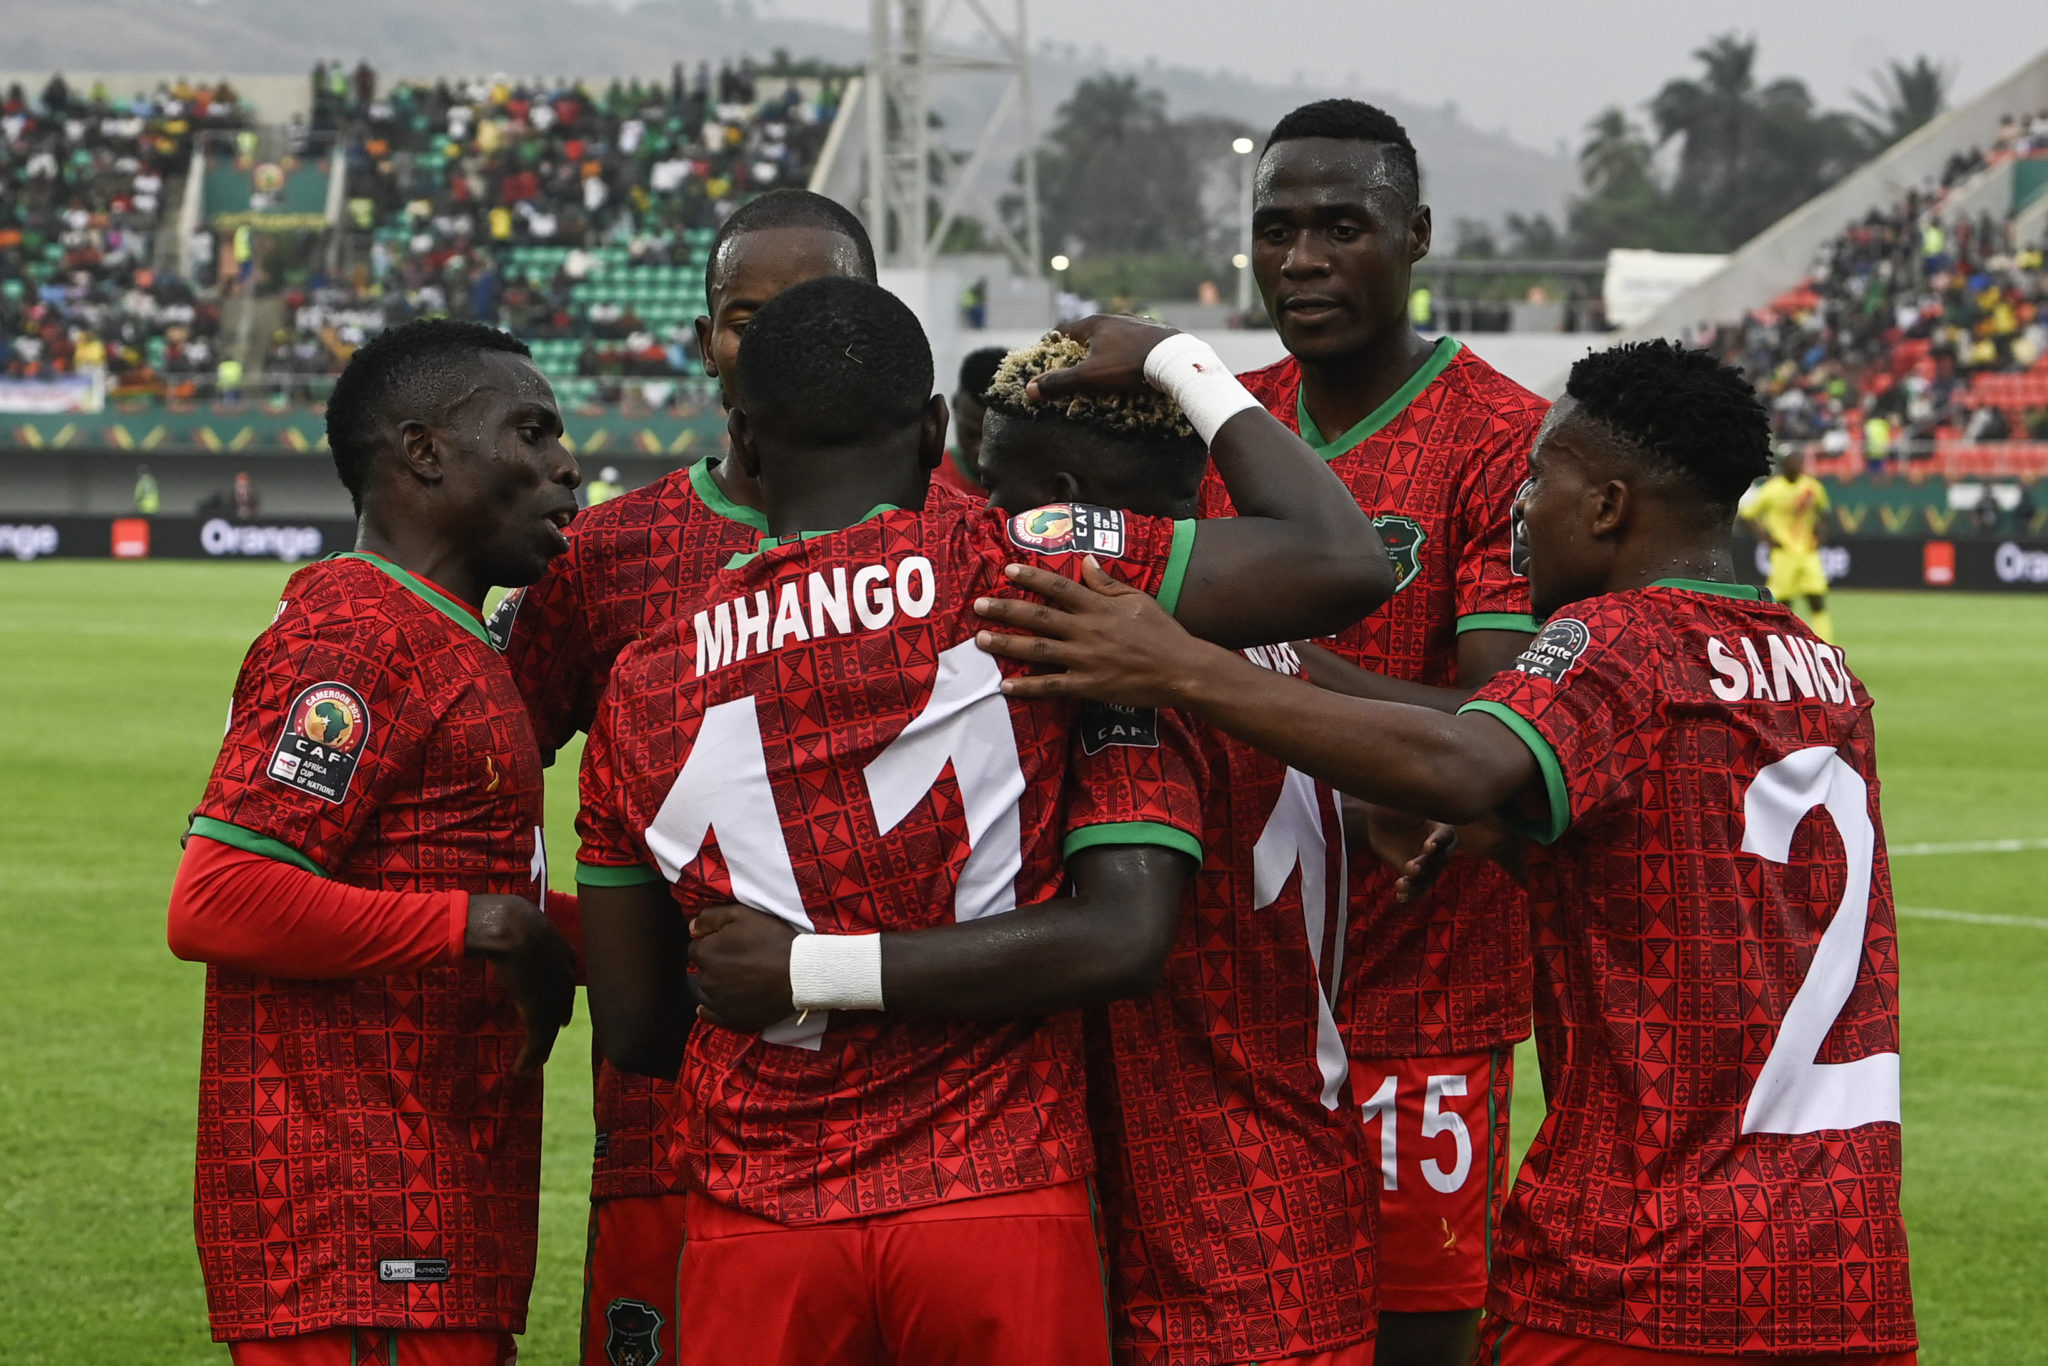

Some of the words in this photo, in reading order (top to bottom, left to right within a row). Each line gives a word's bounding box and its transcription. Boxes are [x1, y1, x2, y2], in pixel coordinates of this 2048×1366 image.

[1075, 506, 1088, 537] CAF
[693, 556, 936, 678] MHANGO
[1541, 643, 1572, 660] rate
[305, 690, 351, 707] CAMEROON
[349, 703, 362, 723] 2021
[1097, 724, 1142, 740] CAF
[295, 739, 341, 763] CAF
[300, 768, 314, 778] CUP
[302, 760, 327, 775] AFRICA
[297, 776, 306, 785] OF
[306, 780, 336, 797] NATIONS
[644, 636, 1027, 1051] 11
[1253, 765, 1348, 1112] 1
[1740, 746, 1900, 1135] 2
[1361, 1074, 1473, 1194] 15
